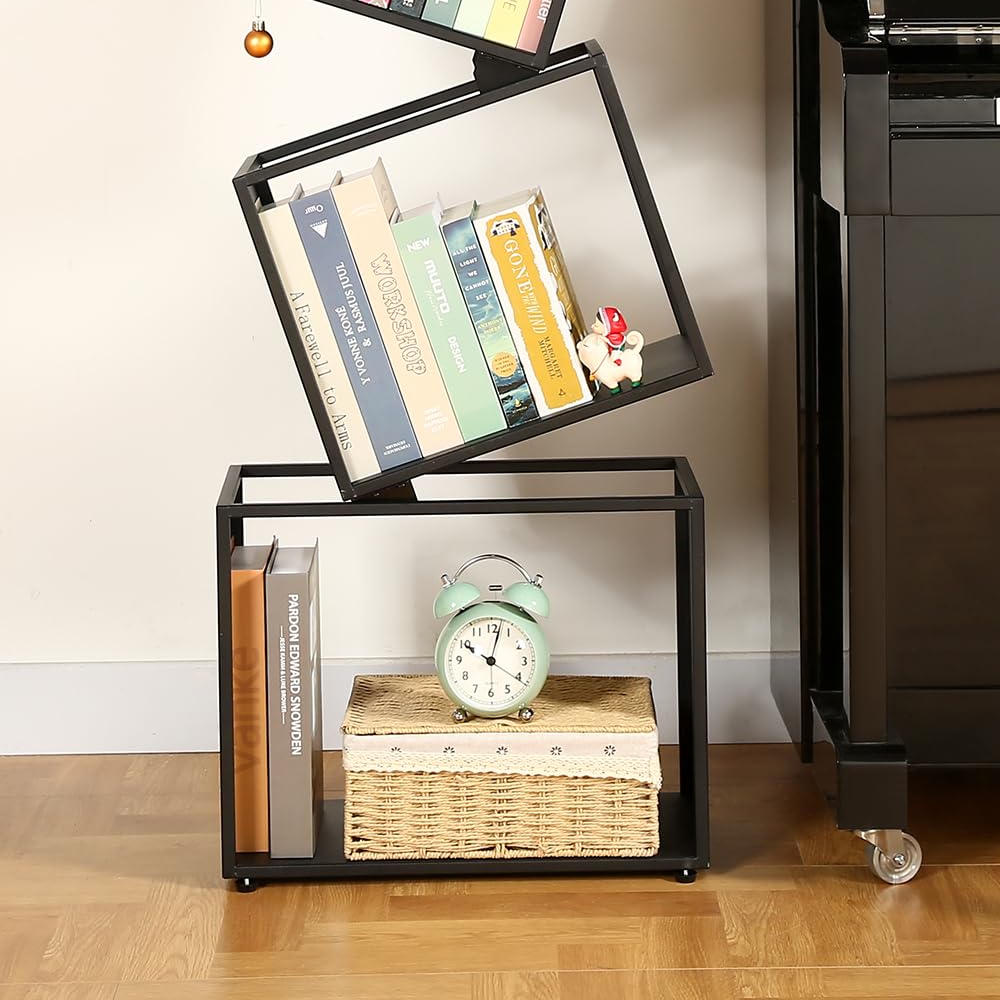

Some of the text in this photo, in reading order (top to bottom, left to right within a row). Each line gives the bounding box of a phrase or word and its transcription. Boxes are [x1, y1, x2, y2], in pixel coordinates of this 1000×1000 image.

[406, 236, 432, 253] NEW
[452, 243, 477, 256] ALL THE
[458, 256, 478, 268] LIGHT
[466, 269, 478, 278] WE
[463, 279, 490, 292] CANNOT
[503, 238, 533, 294] GONE
[524, 302, 548, 336] WIND
[475, 292, 488, 301] SEE
[334, 260, 373, 347] & RASMUS JUUL
[333, 303, 354, 337] KONÉ
[369, 251, 426, 378] WORKSHOP
[447, 336, 466, 373] DESIGN
[537, 339, 555, 379] MITCHELL
[543, 336, 562, 378] MARGARET
[288, 288, 356, 451] A Farewell to Arms
[472, 627, 481, 637] 11
[487, 623, 498, 634] 12
[460, 639, 471, 649] 10
[456, 655, 462, 664] 9
[521, 656, 528, 666] 3
[288, 594, 301, 755] PARDON EDWARD SNOWDEN
[462, 671, 469, 680] 8
[472, 684, 478, 693] 7
[488, 688, 494, 697] 6
[504, 684, 511, 694] 5
